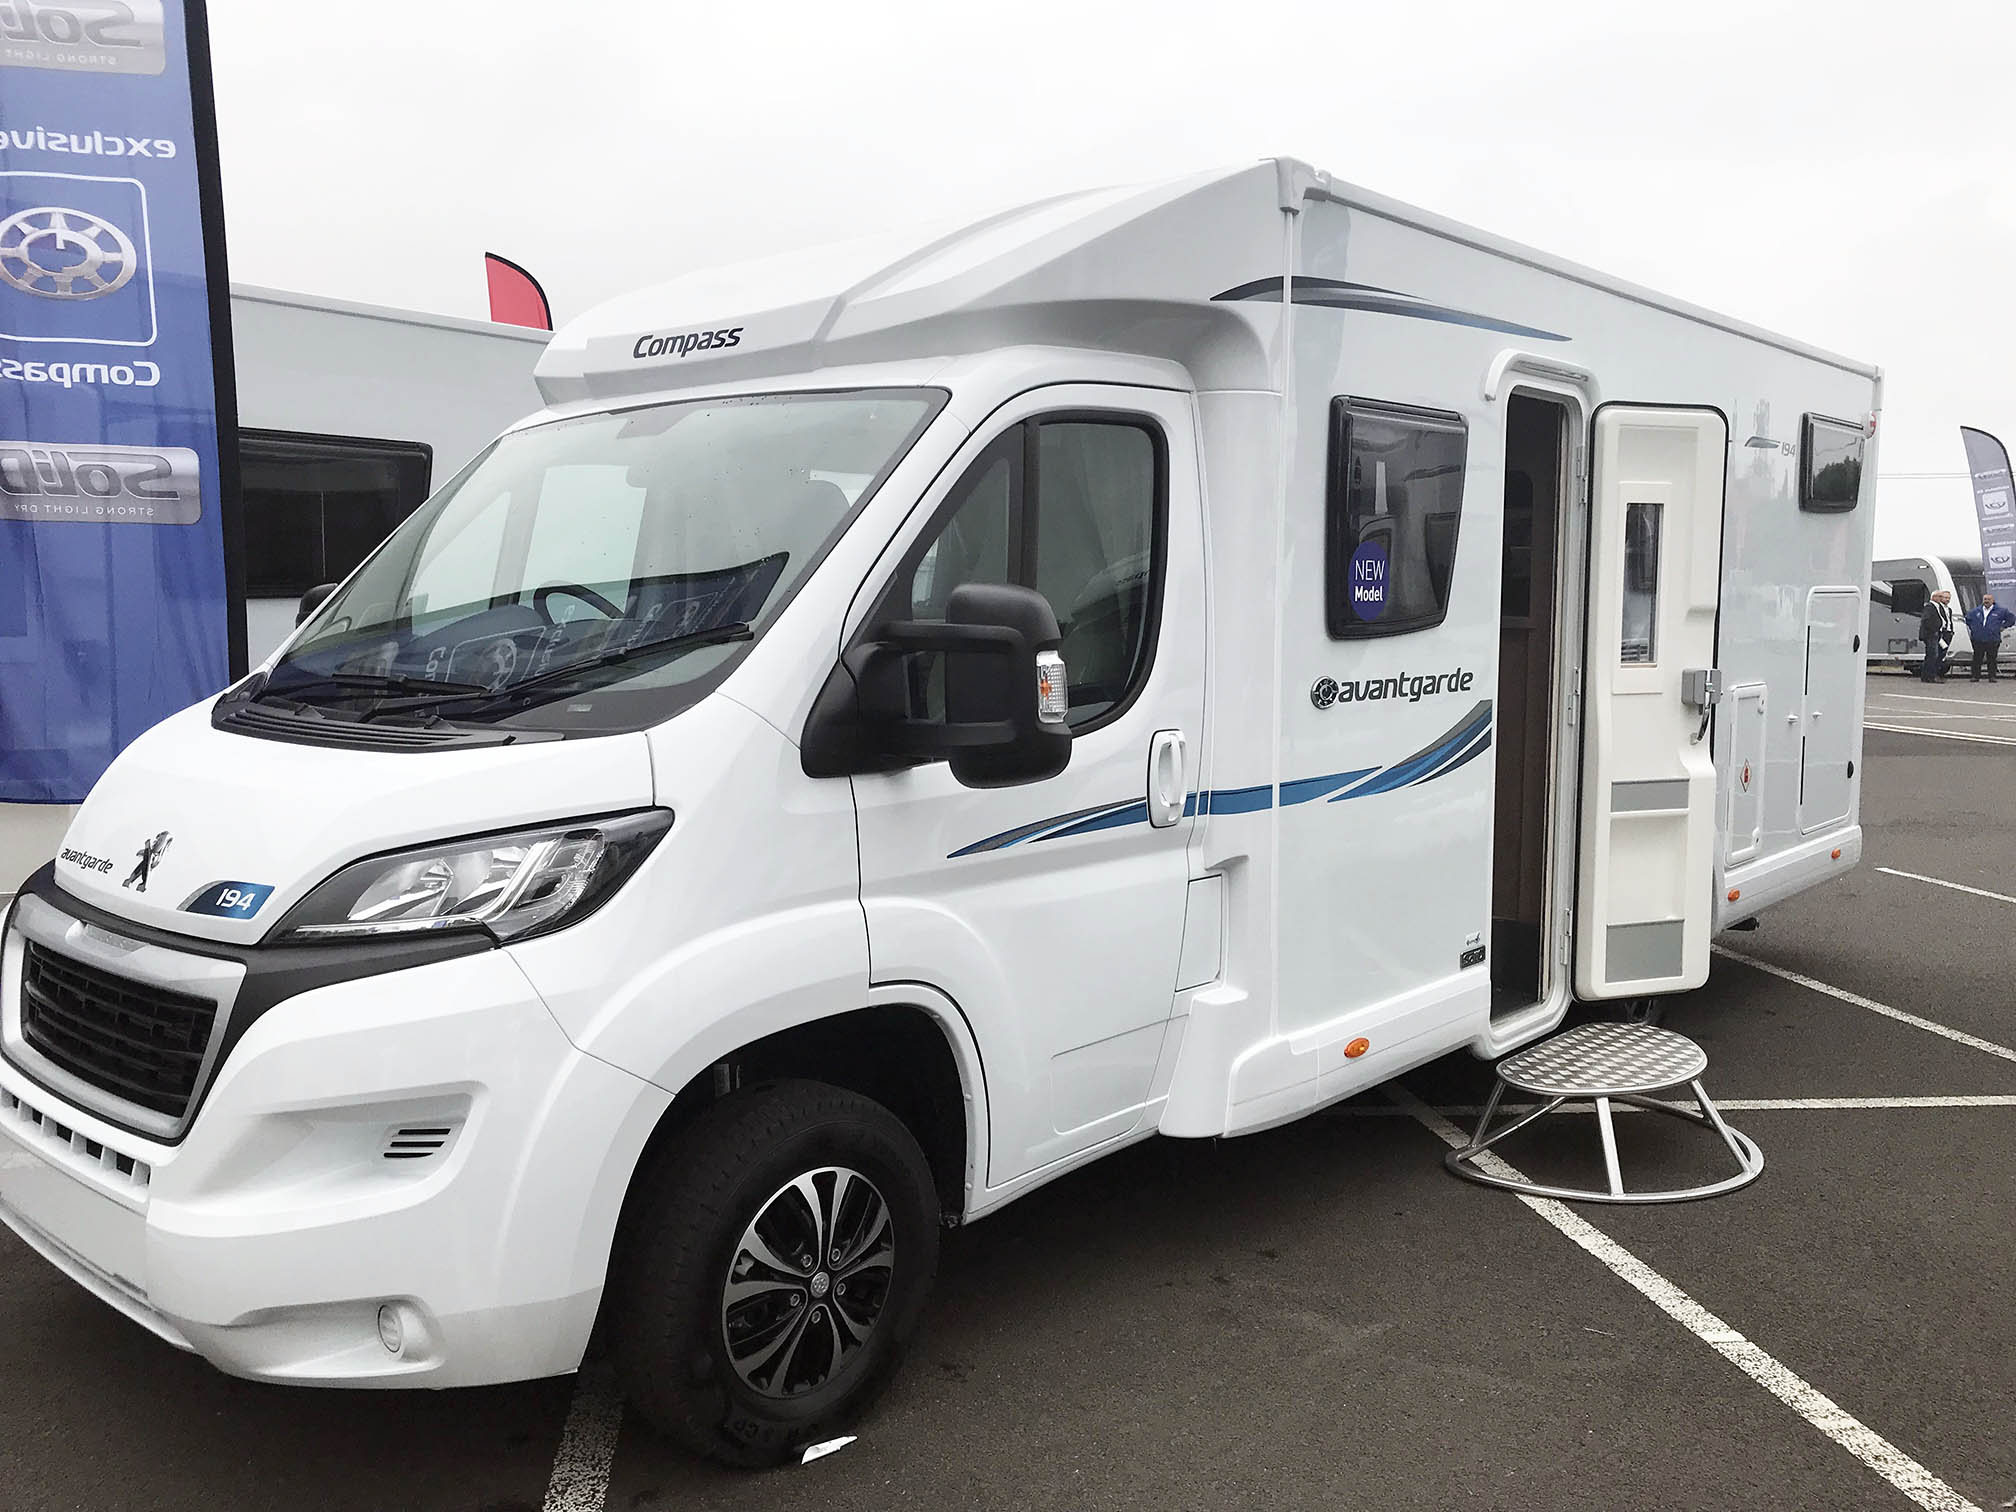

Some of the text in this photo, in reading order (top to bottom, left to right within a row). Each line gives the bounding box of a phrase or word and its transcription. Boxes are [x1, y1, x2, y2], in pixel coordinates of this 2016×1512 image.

[633, 327, 744, 359] Compass
[1781, 441, 1796, 457] 194
[1355, 560, 1386, 582] NEW
[1354, 586, 1384, 603] Model
[1338, 667, 1474, 703] avantgarde
[60, 847, 113, 875] avantgarde
[215, 888, 256, 912] 194
